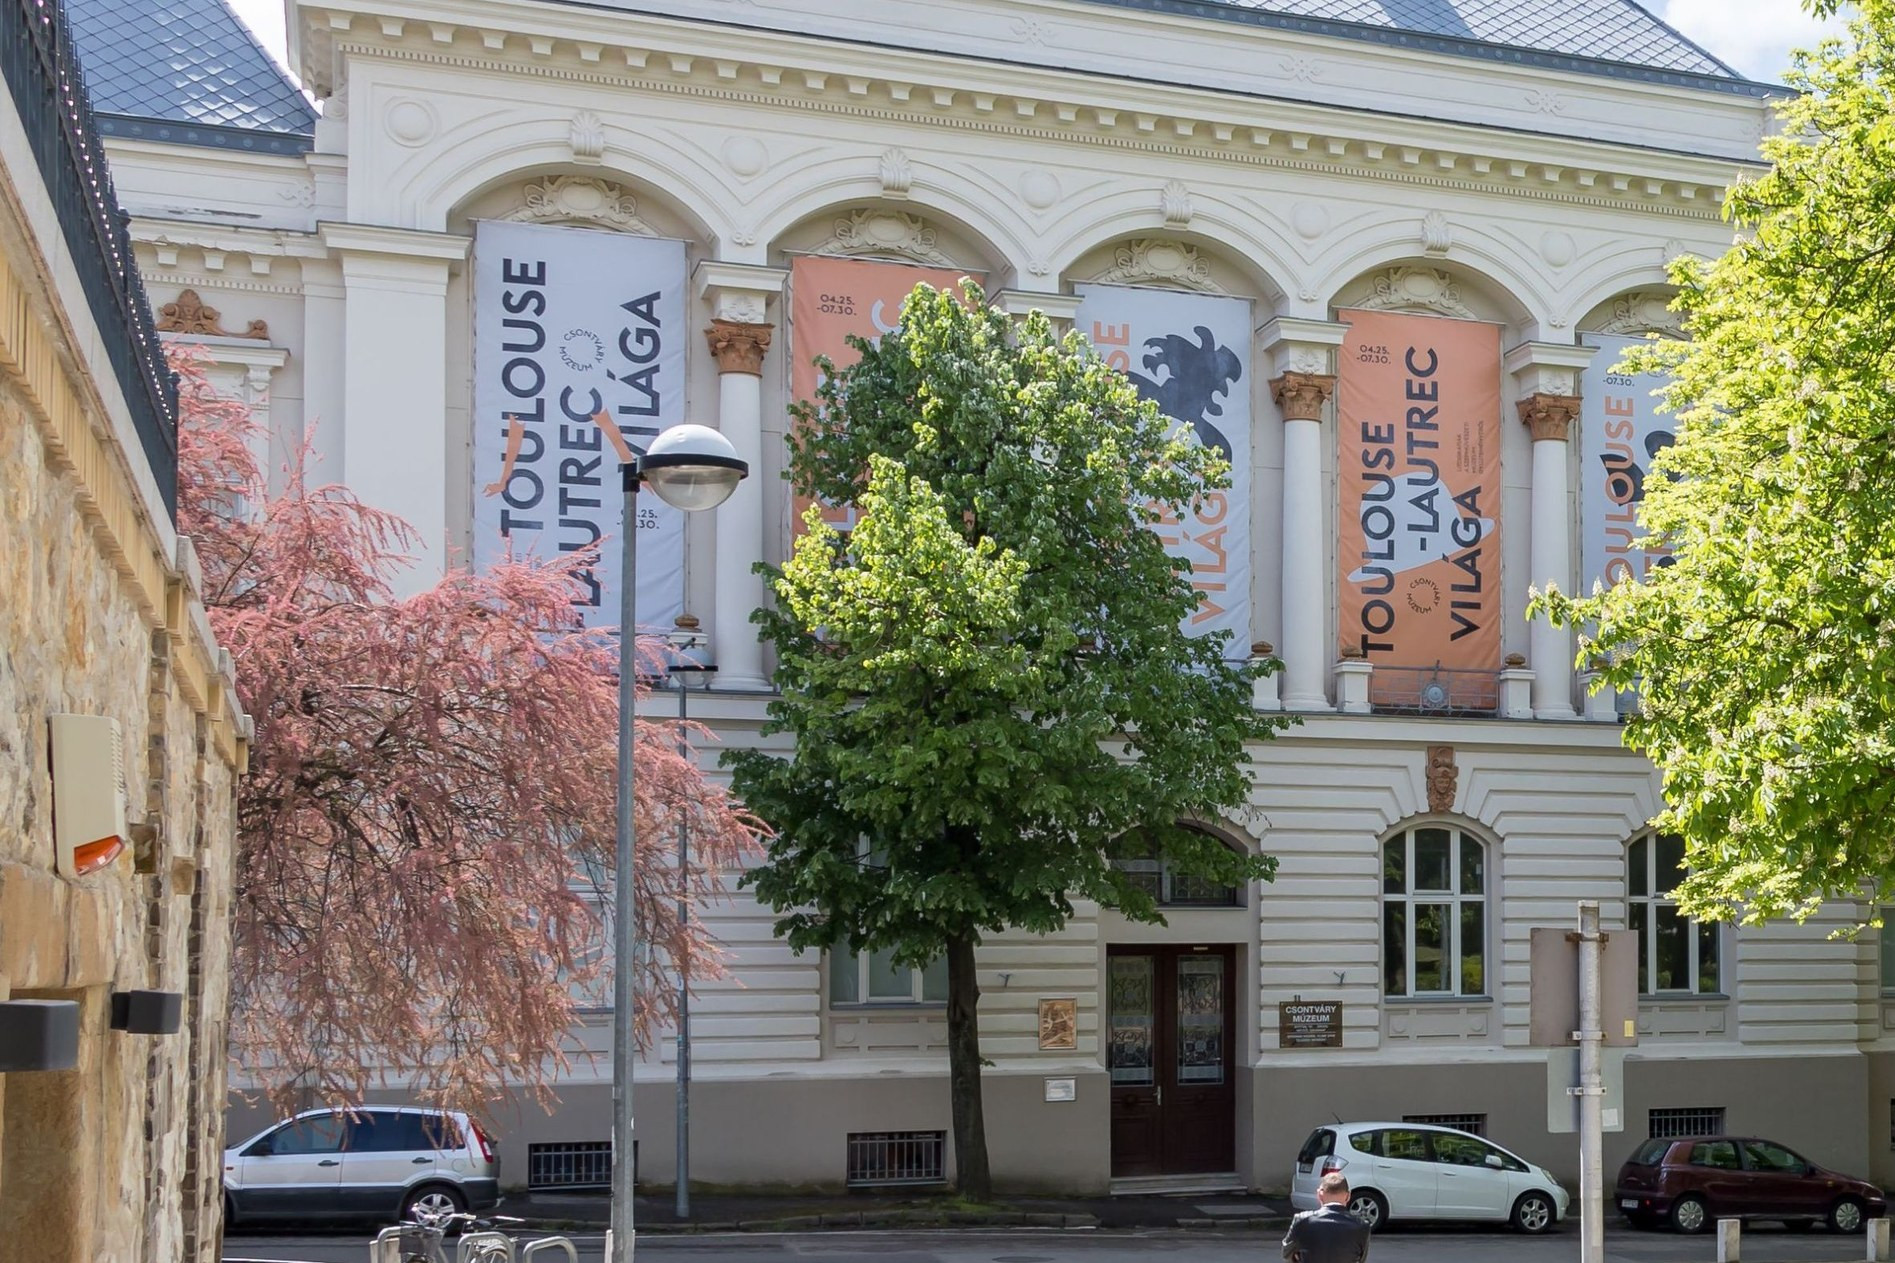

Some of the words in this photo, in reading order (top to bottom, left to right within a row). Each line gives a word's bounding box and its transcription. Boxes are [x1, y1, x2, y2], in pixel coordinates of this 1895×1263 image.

[820, 294, 855, 306] 04.25.
[816, 304, 857, 316] -07.30.
[563, 328, 606, 364] CSONTVÁRY
[1360, 344, 1390, 355] 04.25.
[1356, 354, 1391, 365] -07.30.
[1602, 377, 1635, 387] -07.30.
[501, 258, 546, 537] TOULOUSE
[1405, 346, 1440, 551] -LAUTREC
[1605, 396, 1635, 587] OULOUSE
[620, 508, 658, 519] .25.
[617, 519, 660, 529] -.30.
[1361, 421, 1395, 658] TOULOUSE
[1183, 474, 1228, 625] VILÁG
[1442, 486, 1482, 641] VILÁGA
[1285, 1004, 1337, 1014] CSONTVÁRY
[1292, 1013, 1330, 1023] MÚZEUM
